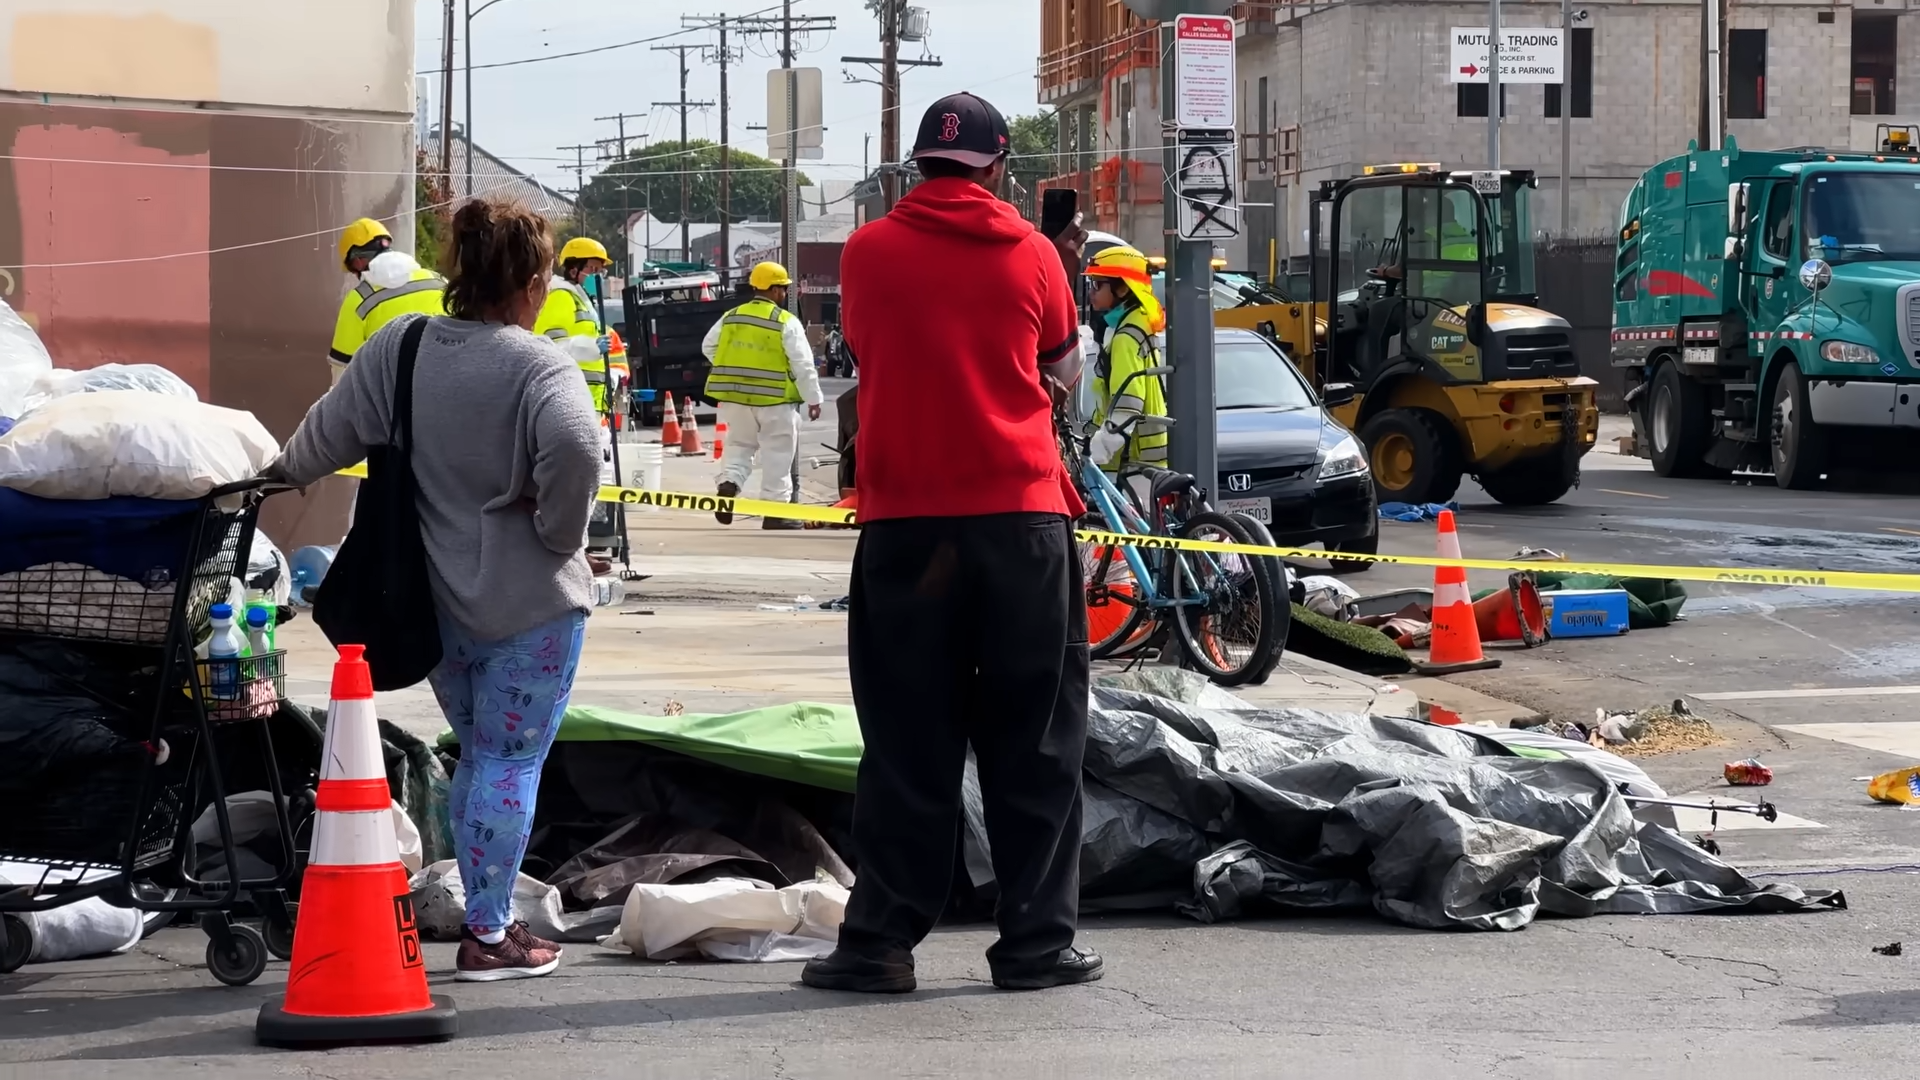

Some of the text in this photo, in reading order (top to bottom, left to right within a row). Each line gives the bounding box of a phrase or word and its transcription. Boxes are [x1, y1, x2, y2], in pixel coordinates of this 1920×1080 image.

[1457, 35, 1558, 46] MUTUL TRADING
[1480, 66, 1508, 74] OFCE
[1511, 66, 1517, 74] &
[938, 112, 961, 141] B
[1431, 336, 1449, 349] CAT
[619, 490, 735, 513] CAUTION
[1567, 614, 1604, 627] Modelo
